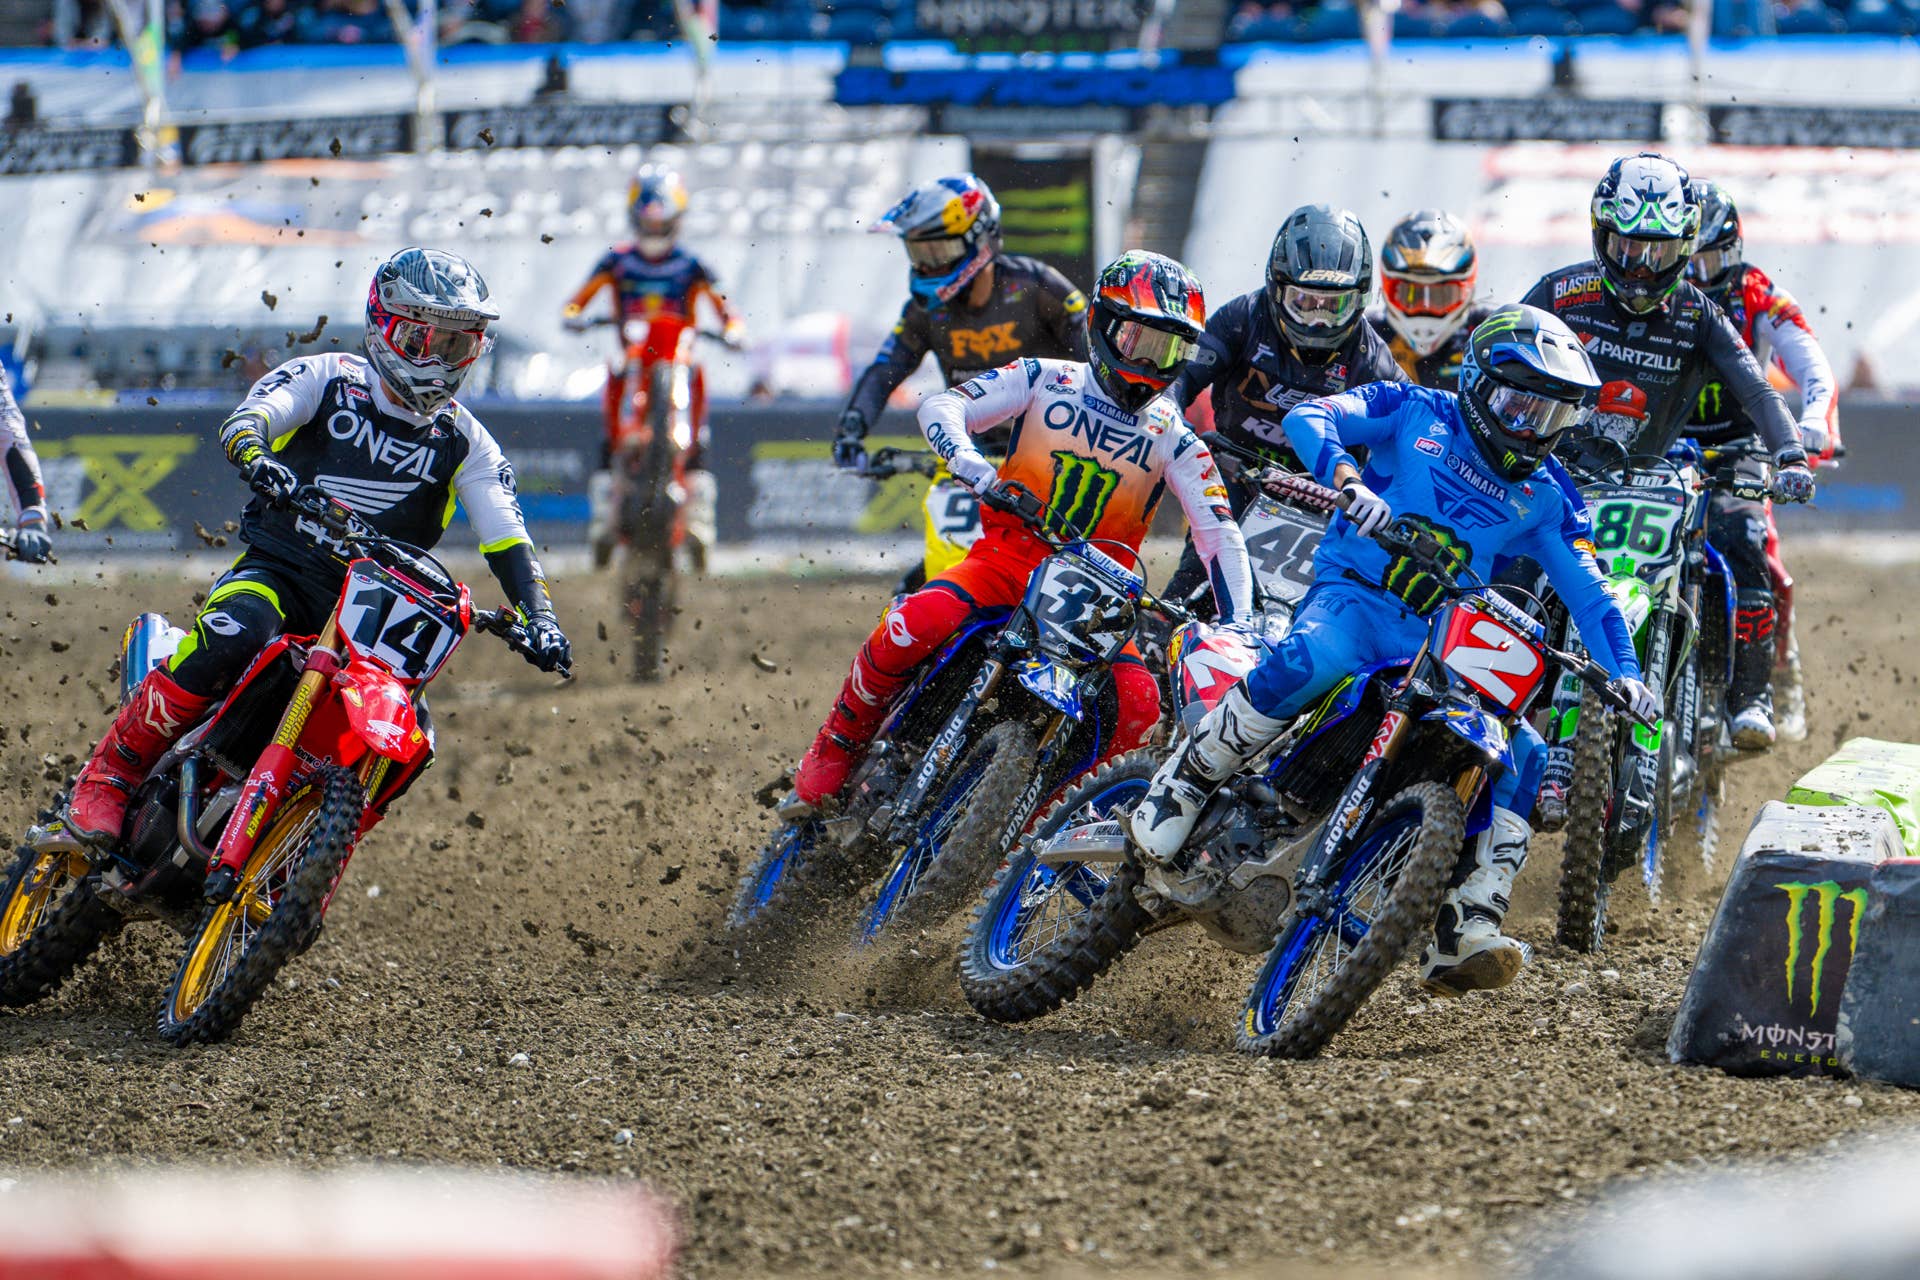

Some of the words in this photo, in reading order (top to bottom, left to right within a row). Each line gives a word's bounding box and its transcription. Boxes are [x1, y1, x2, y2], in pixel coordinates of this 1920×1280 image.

[1554, 293, 1602, 310] POWER
[1555, 276, 1601, 299] BLASTER
[1600, 341, 1681, 371] PARTZILLA
[1095, 401, 1136, 426] YAMAHA
[1264, 482, 1337, 510] RENTHA
[1267, 472, 1342, 499] RENTHA
[1457, 463, 1506, 501] YAMAHA
[1735, 486, 1763, 499] ASV
[1595, 502, 1673, 556] 86
[351, 586, 443, 679] 14
[1444, 620, 1539, 707] 2
[1683, 662, 1697, 743] DUNLOP
[1000, 773, 1043, 851] DUNLOP
[1325, 775, 1372, 855] DUNLOP
[1740, 1024, 1836, 1050] MONST
[1760, 1050, 1838, 1067] ENERG
